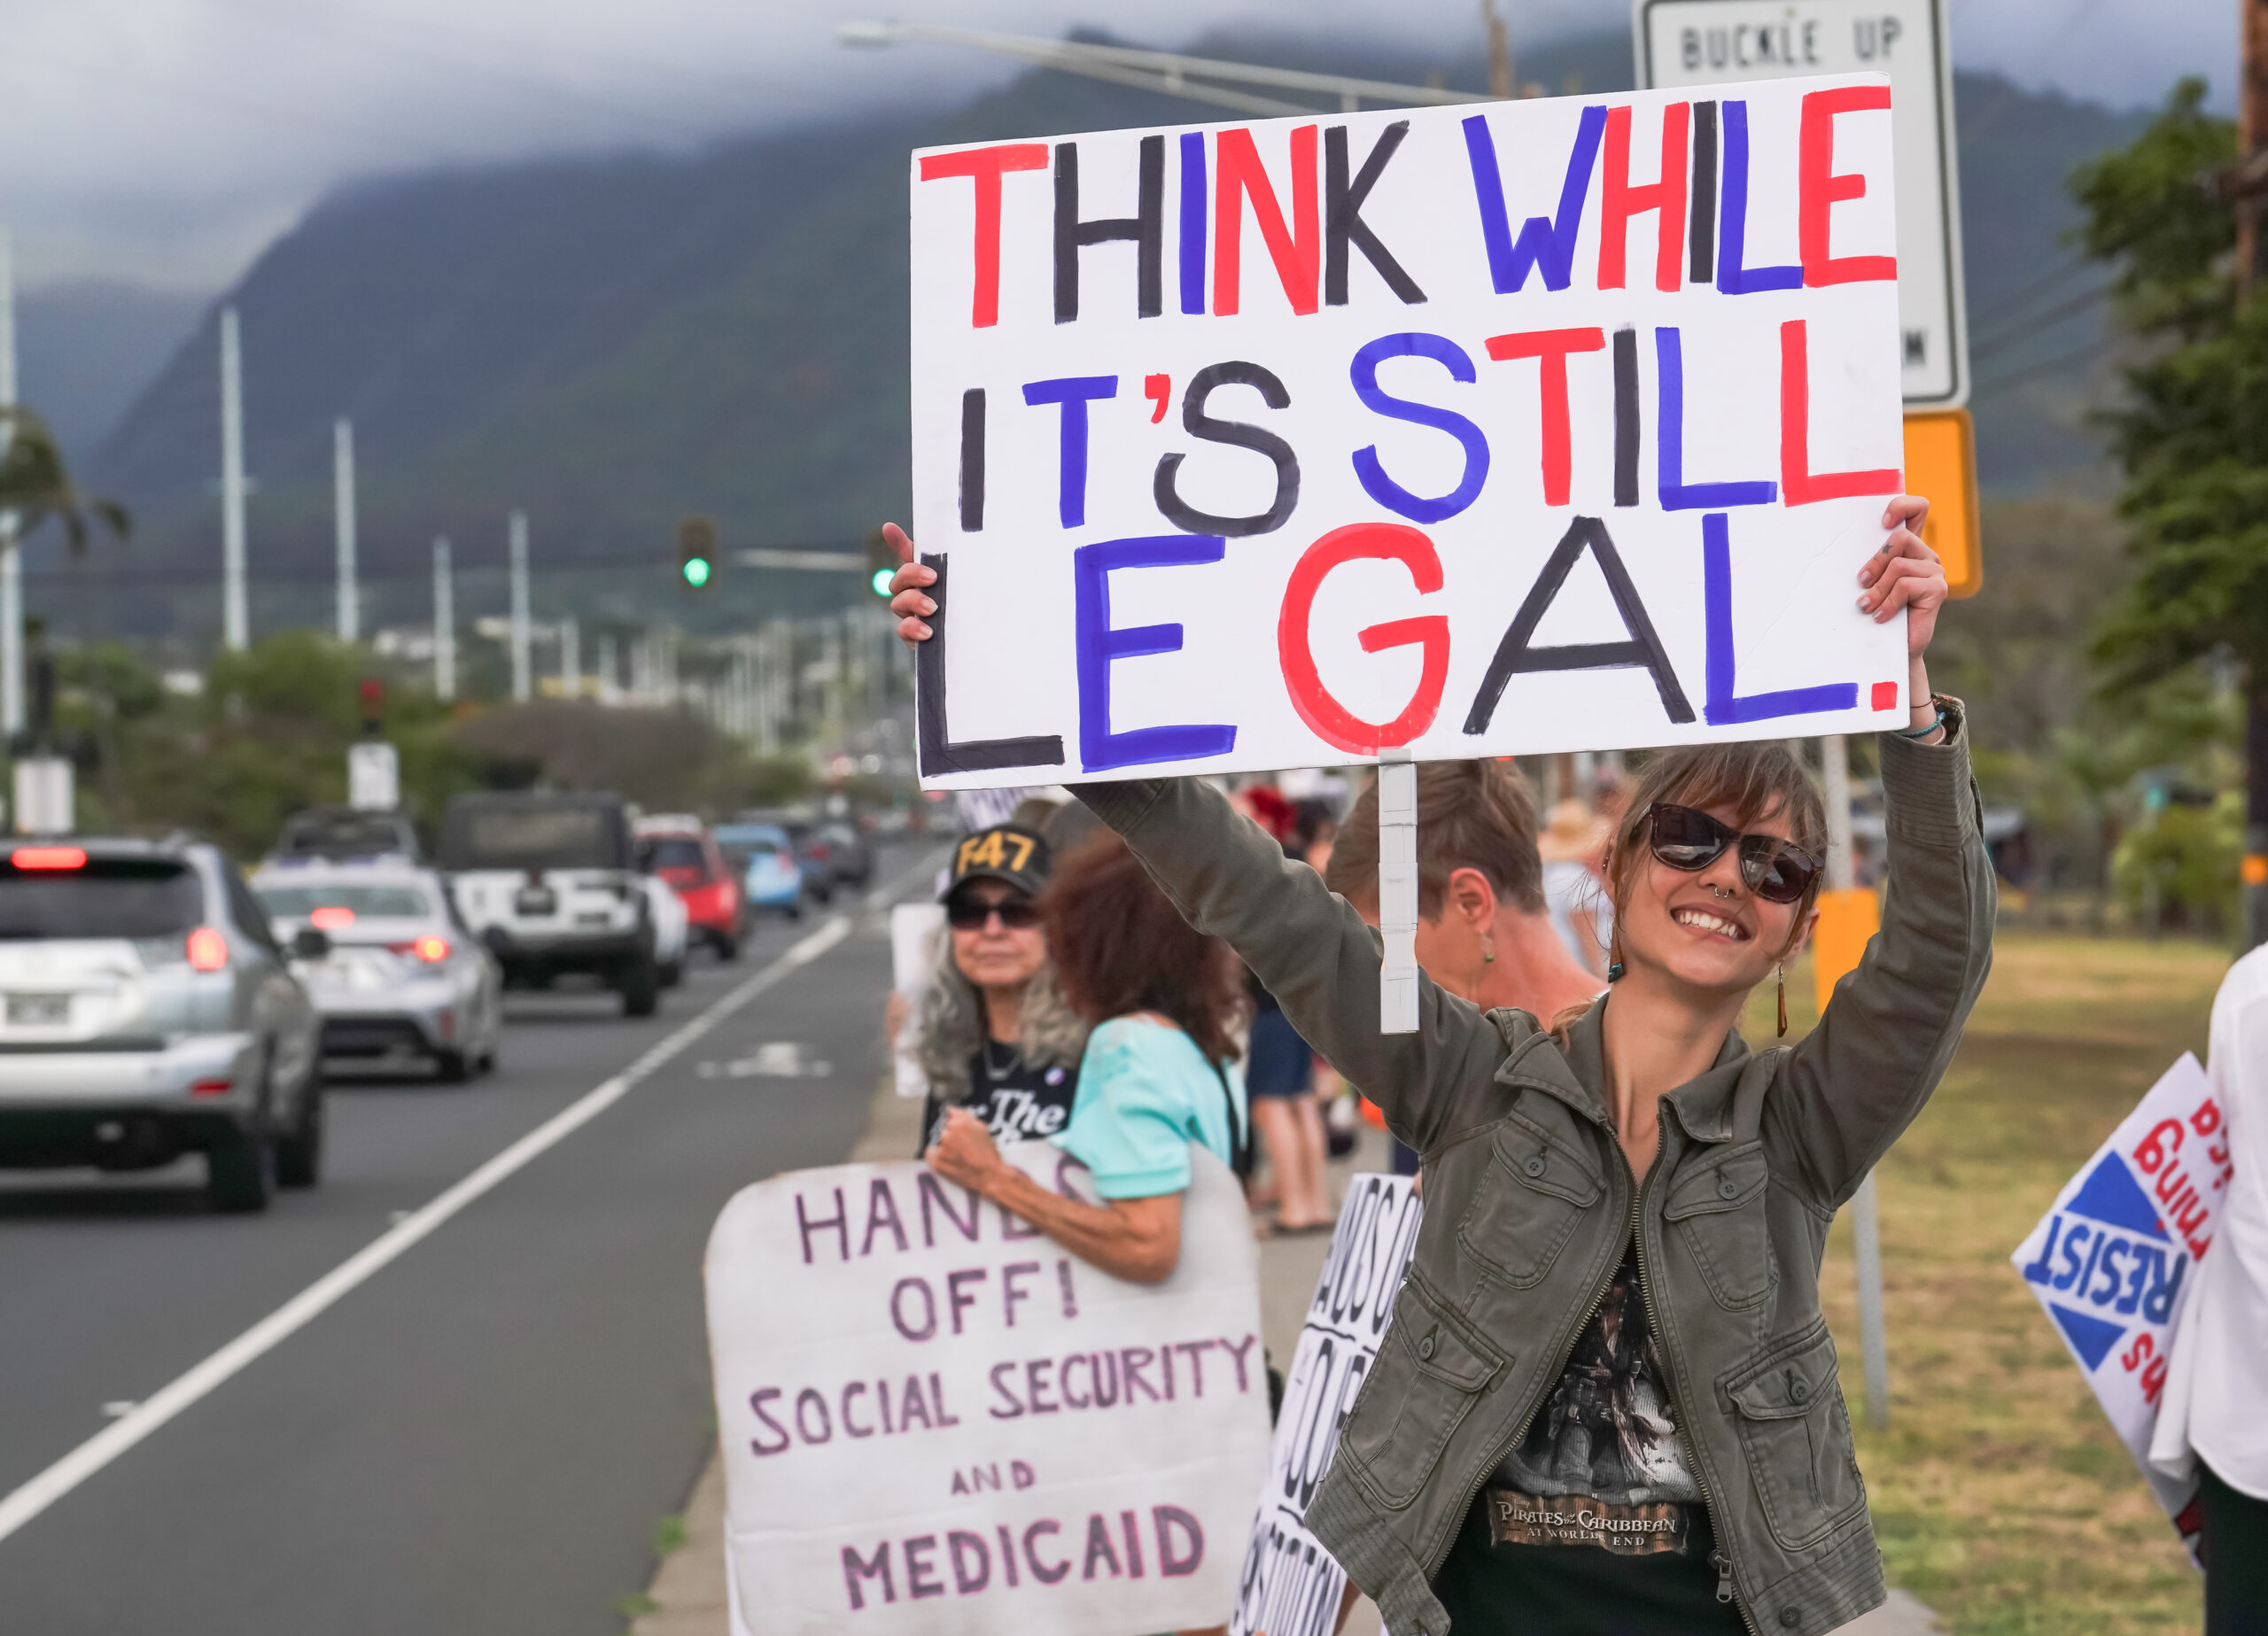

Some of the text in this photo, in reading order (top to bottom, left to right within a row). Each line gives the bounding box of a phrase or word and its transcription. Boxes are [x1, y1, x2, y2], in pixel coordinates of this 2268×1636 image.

[1682, 15, 1901, 70] BUCKLE UP
[919, 86, 1898, 329] THINK WHILE
[959, 320, 1905, 539] IT'S STILL
[916, 509, 1898, 778] LEGAL.
[988, 1089, 1067, 1135] The
[890, 1259, 1079, 1342] OFF!
[2023, 1215, 2187, 1325] RESIST
[749, 1333, 1256, 1457] SOCIAL SECURITY
[951, 1460, 1036, 1495] AND
[1496, 1500, 1564, 1526] PIRATES
[1578, 1509, 1677, 1533] CARIBBEAN
[841, 1504, 1206, 1610] MEDICAID
[1527, 1527, 1542, 1538] AT
[1613, 1536, 1645, 1547] END
